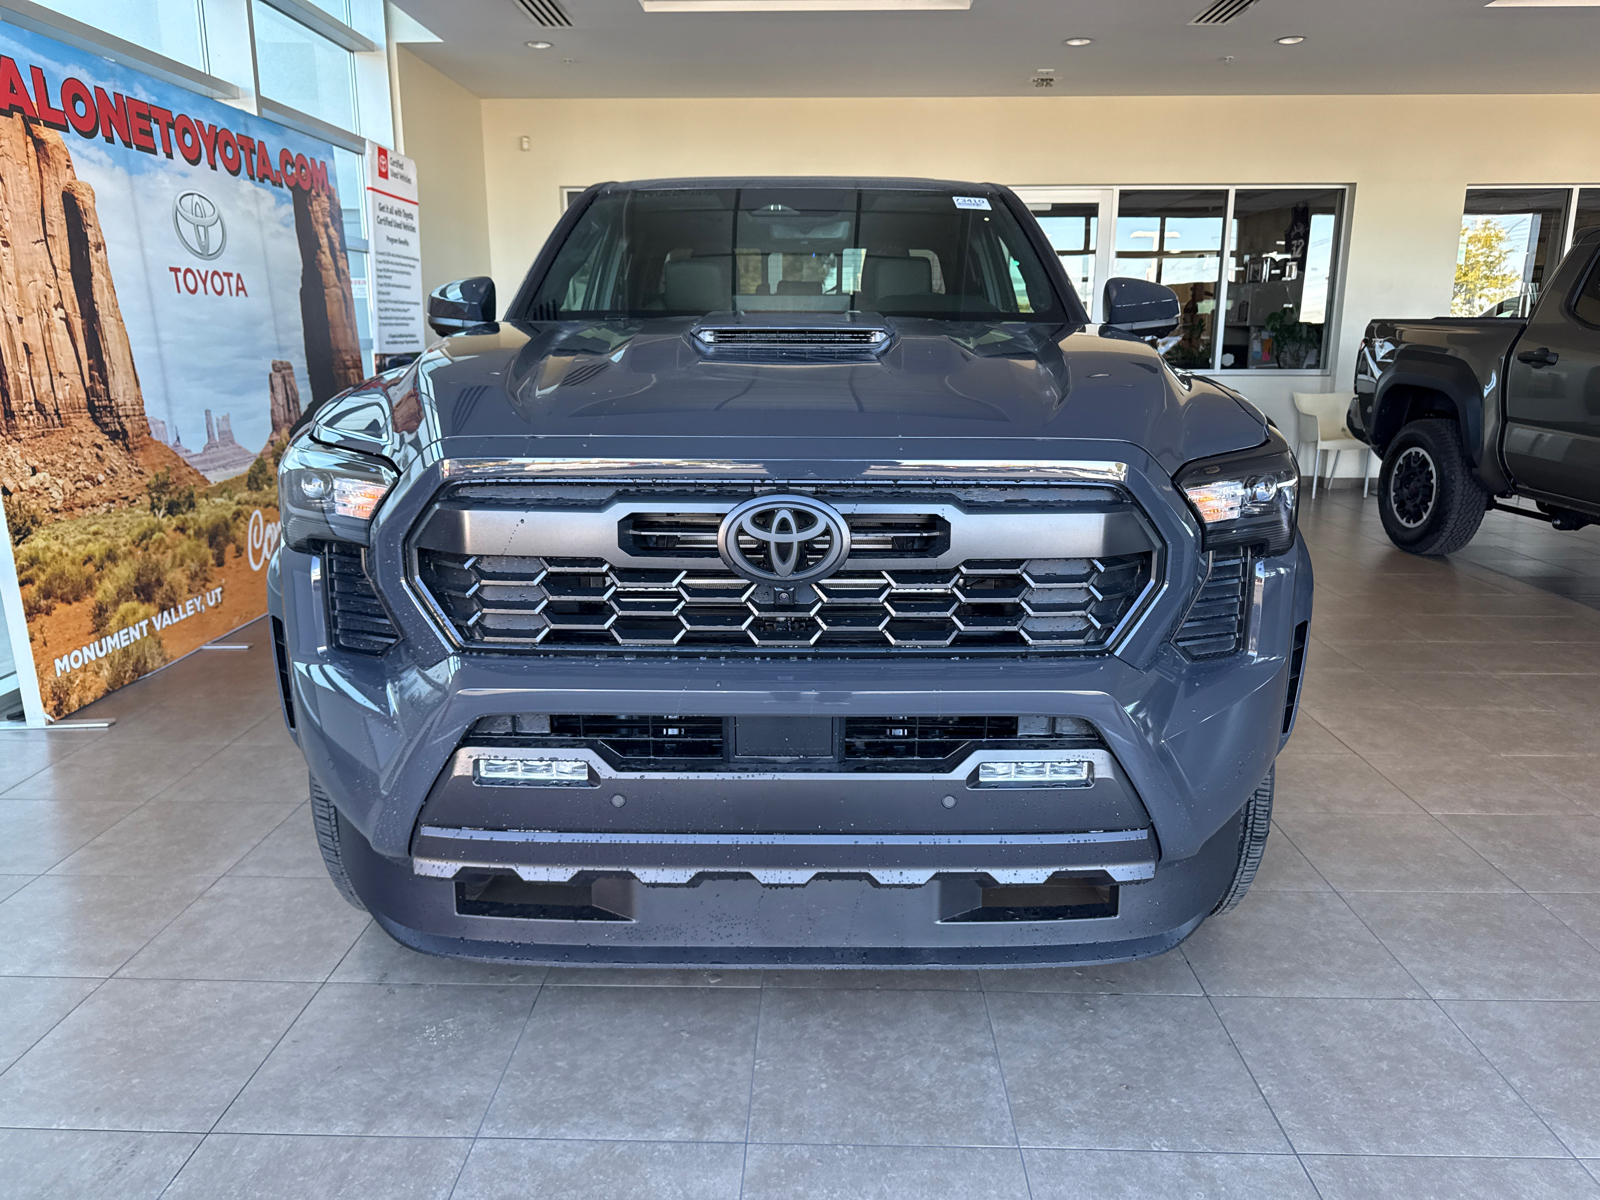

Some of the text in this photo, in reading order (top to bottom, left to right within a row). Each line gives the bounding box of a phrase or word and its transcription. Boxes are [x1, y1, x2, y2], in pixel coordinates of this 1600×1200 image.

[168, 266, 249, 298] TOYOTA
[54, 586, 223, 678] MONUMENT VALLEY, UT
